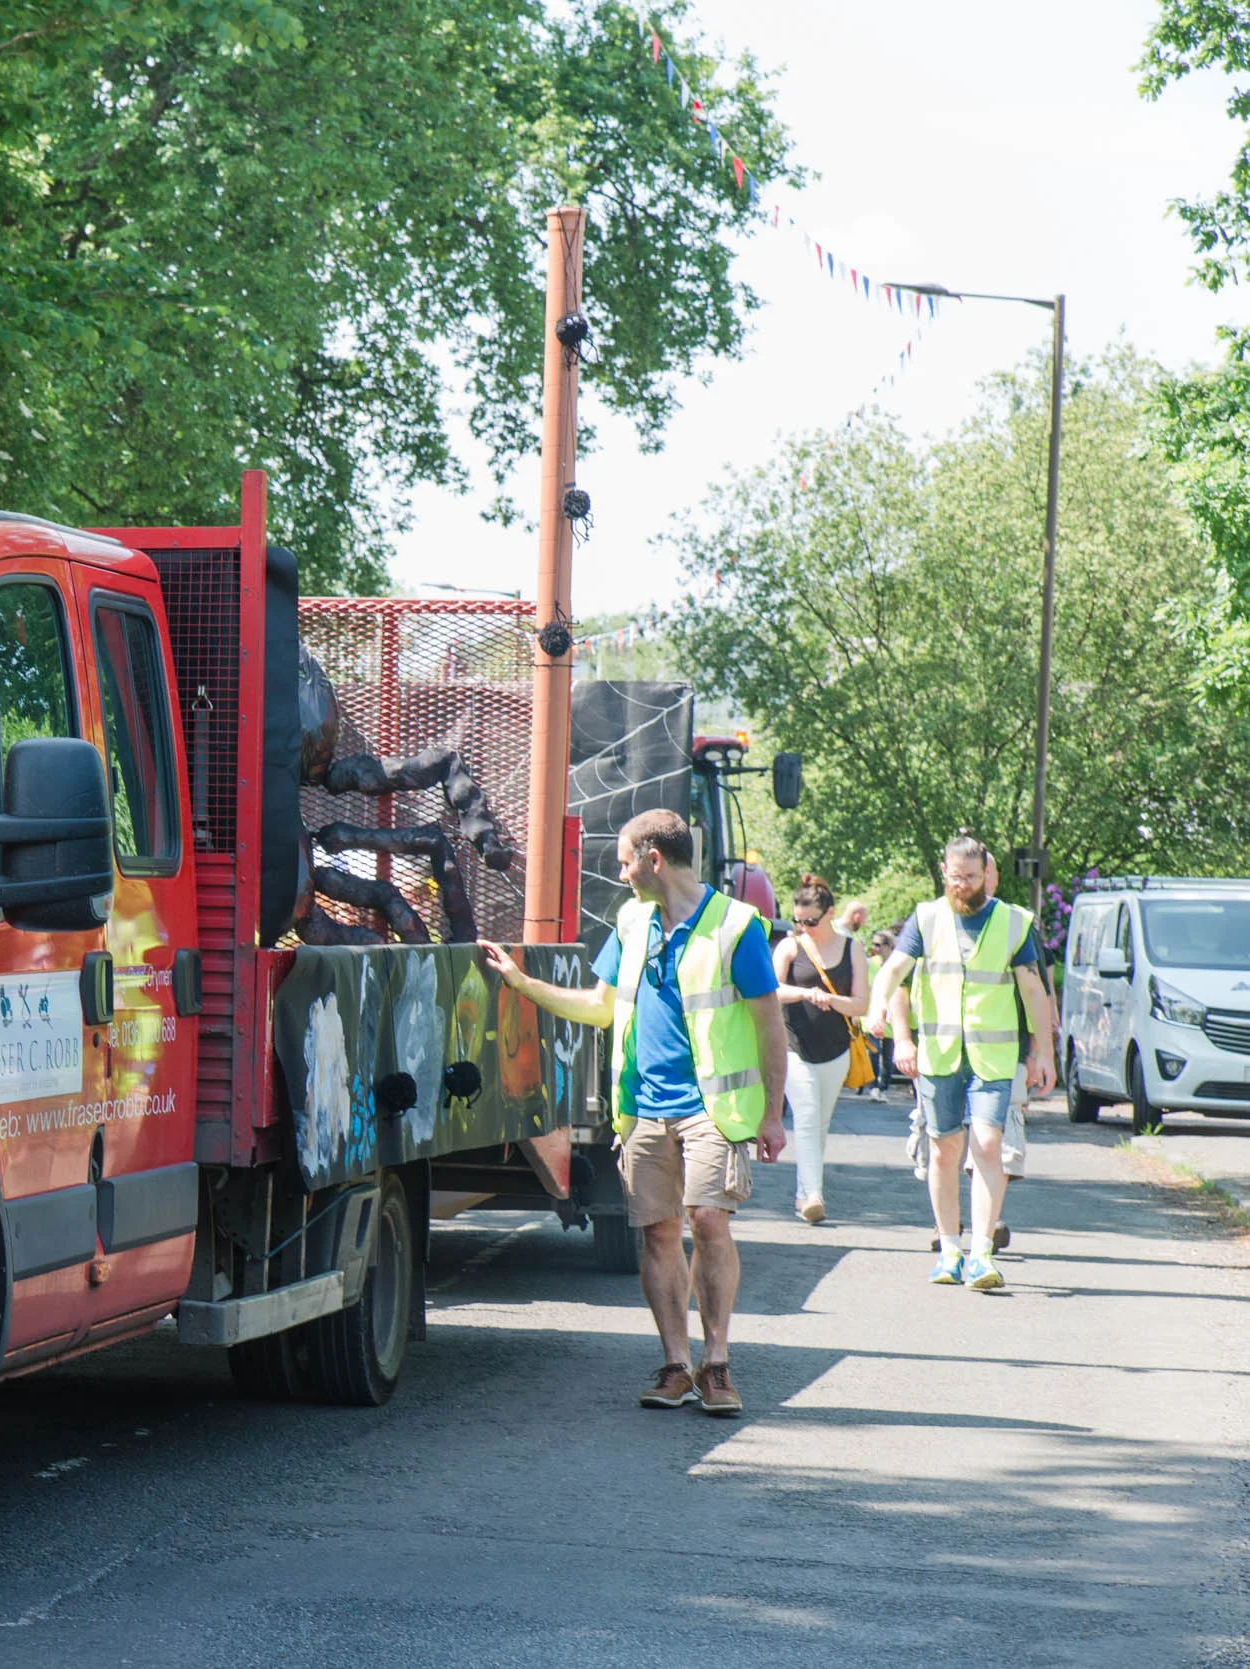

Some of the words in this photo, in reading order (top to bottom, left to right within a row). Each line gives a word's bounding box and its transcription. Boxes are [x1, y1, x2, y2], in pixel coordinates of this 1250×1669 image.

[107, 1021, 119, 1049] Tel:
[161, 1015, 176, 1042] 688
[29, 1039, 43, 1072] C.
[45, 1037, 79, 1070] ROBB
[26, 1087, 177, 1134] www.frasercrobb.co.uk
